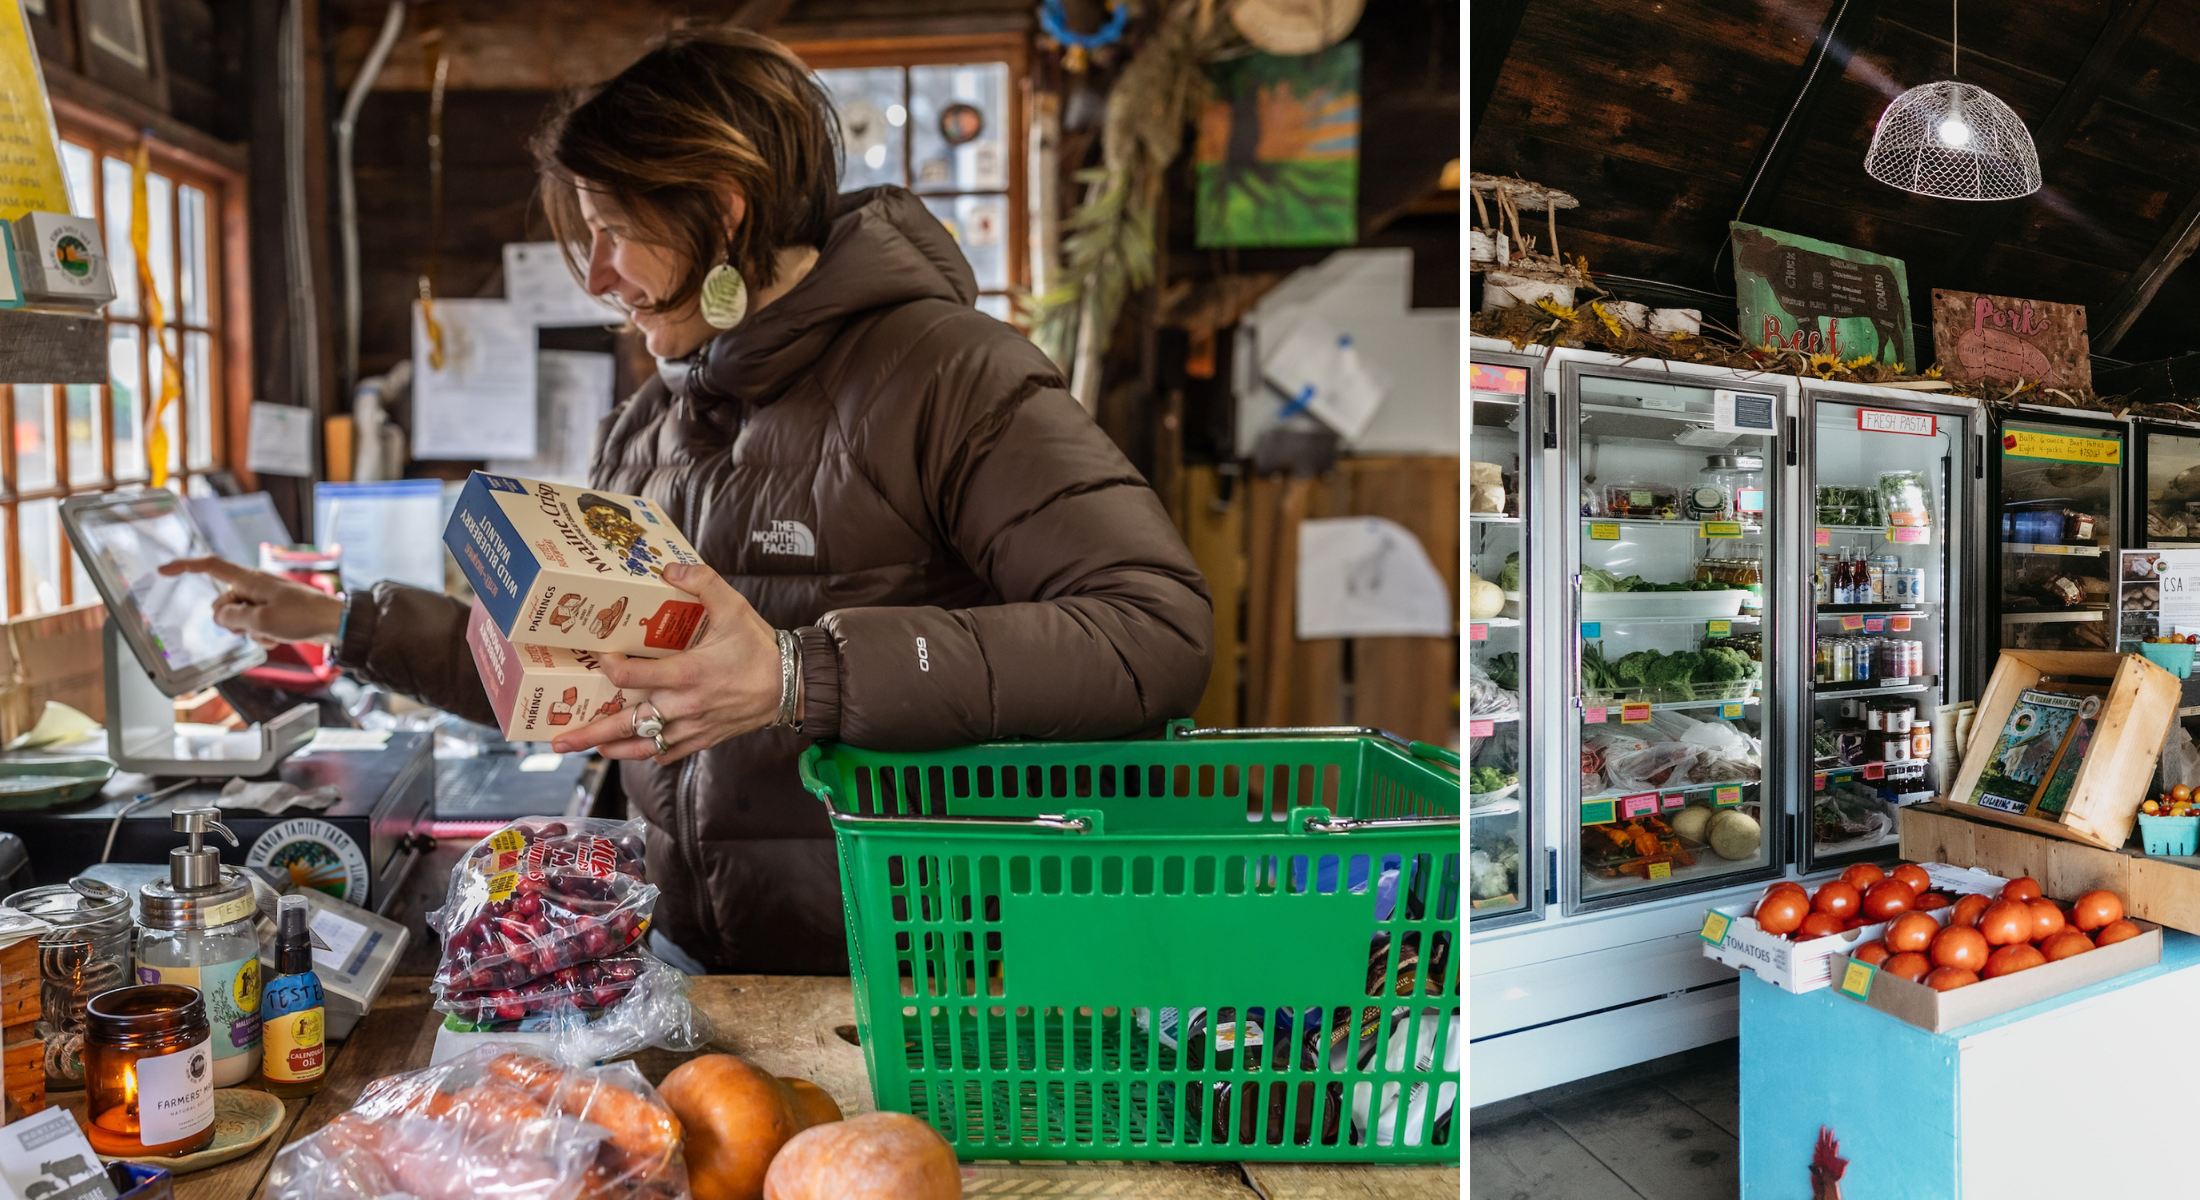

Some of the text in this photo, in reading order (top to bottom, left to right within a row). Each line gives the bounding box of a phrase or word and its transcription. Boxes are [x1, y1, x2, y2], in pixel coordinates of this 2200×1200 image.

[1785, 252, 1796, 289] CHUCK
[1813, 271, 1825, 289] RIB
[1875, 274, 1888, 311] ROUND
[1974, 297, 2051, 337] Pork
[1763, 313, 1845, 359] Beef
[1866, 413, 1928, 432] FRESH PASTA
[2018, 433, 2035, 442] Bulk
[2069, 438, 2083, 446] Beef
[2086, 440, 2105, 448] Patties
[2018, 444, 2035, 454] Eight
[2039, 446, 2063, 455] 4-packs
[479, 515, 511, 565] WALNUT
[535, 483, 614, 574] Maine Crisp
[752, 531, 794, 543] NORTH
[771, 520, 794, 531] THE
[460, 508, 518, 599] WILD BLUEBERRY
[762, 543, 794, 554] FACE
[2163, 577, 2183, 592] CSA
[529, 585, 556, 632] PAIRINGS
[479, 623, 505, 685] CRANBERRY
[485, 618, 506, 665] ALMOND
[916, 636, 929, 672] 600
[525, 686, 544, 730] PAIRINGS
[250, 821, 350, 863] VERNON FAMILY FARM
[1726, 935, 1771, 964] TOMATOES
[157, 1089, 202, 1111] FARMERS'
[170, 1105, 196, 1117] NATURAL
[21, 1117, 68, 1143] MONTHLY
